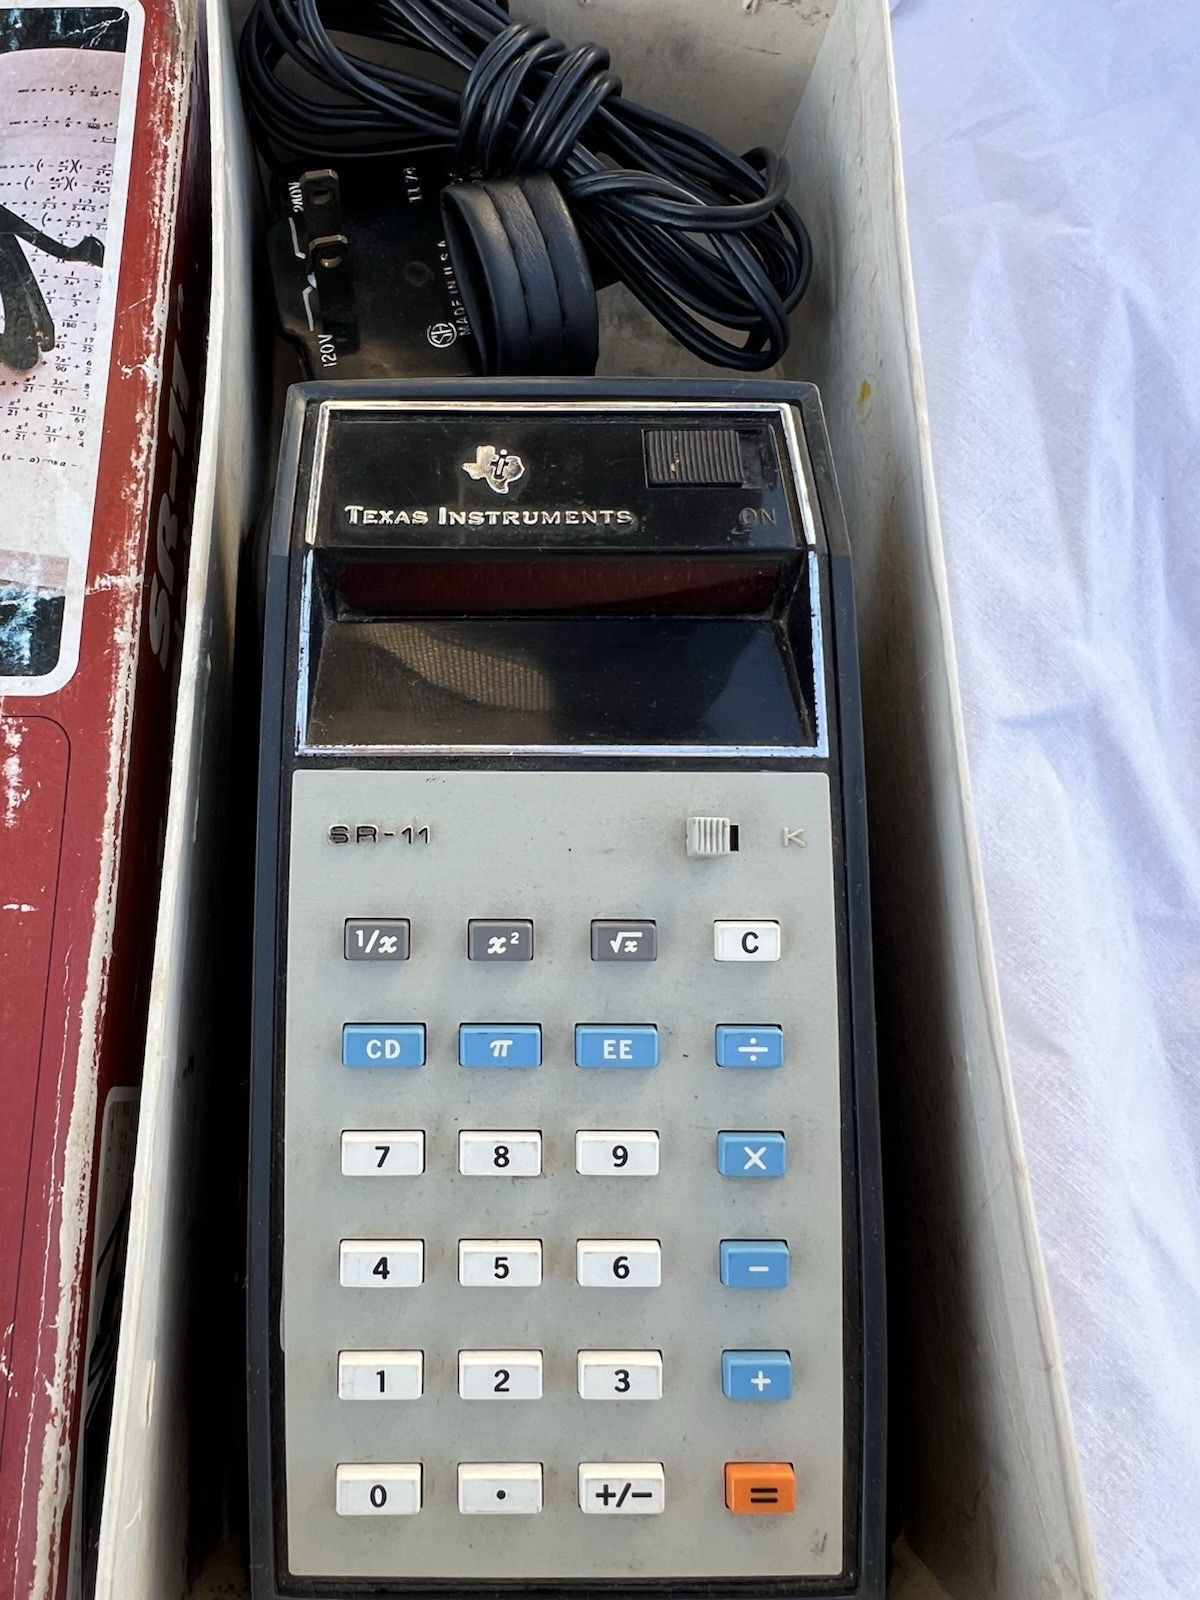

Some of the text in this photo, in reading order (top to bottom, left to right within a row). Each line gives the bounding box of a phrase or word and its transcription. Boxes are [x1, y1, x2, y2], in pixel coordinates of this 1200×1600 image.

[446, 281, 459, 295] IN
[317, 334, 338, 368] 120V
[344, 505, 634, 527] TEXAS INSTRUMENTS
[738, 507, 776, 526] ON
[327, 824, 432, 846] SR-11
[782, 827, 806, 848] K
[741, 932, 760, 954] C
[365, 1039, 402, 1060] CD
[603, 1040, 633, 1060] EE
[374, 1145, 391, 1169] 7
[493, 1145, 510, 1169] 8
[611, 1145, 629, 1169] 9
[371, 1256, 391, 1280] 4
[492, 1256, 510, 1280] 5
[612, 1256, 631, 1280] 6
[375, 1370, 386, 1393] 1
[493, 1370, 510, 1393] 2
[613, 1370, 631, 1393] 3
[370, 1484, 388, 1508] 0
